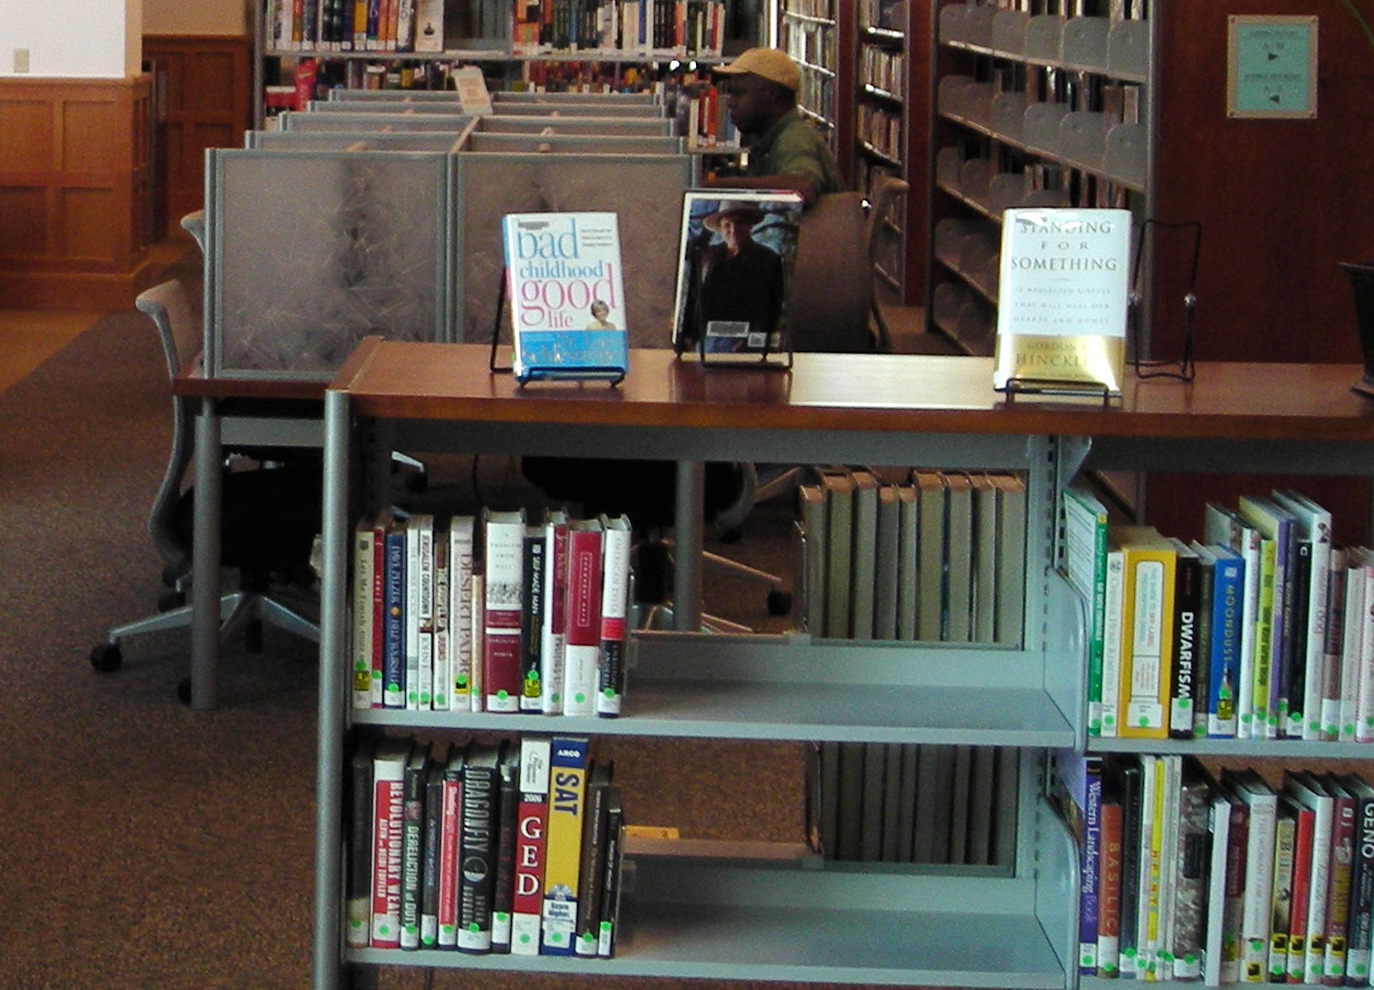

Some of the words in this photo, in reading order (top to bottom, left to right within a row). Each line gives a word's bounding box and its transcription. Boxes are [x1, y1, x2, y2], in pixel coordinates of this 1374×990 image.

[515, 218, 579, 260] bad
[1011, 257, 1117, 271] SOMETHING
[1041, 241, 1090, 251] FOR
[520, 260, 604, 279] childhood
[521, 262, 617, 327] good
[546, 310, 574, 328] life
[460, 553, 472, 620] DESERT
[532, 594, 540, 615] MAN
[1222, 584, 1236, 663] MOONDUST
[460, 628, 472, 674] PADR
[1178, 611, 1193, 700] DWARFISM
[557, 748, 581, 759] ARCO
[463, 769, 492, 853] DRAGONFLY
[553, 771, 580, 817] SAT
[1086, 780, 1101, 826] Western
[388, 781, 404, 882] REVOLUTIONARY
[1360, 802, 1374, 859] GENO
[406, 825, 419, 890] DERELICTION
[516, 816, 543, 897] GED
[1082, 826, 1100, 894] Landscaping
